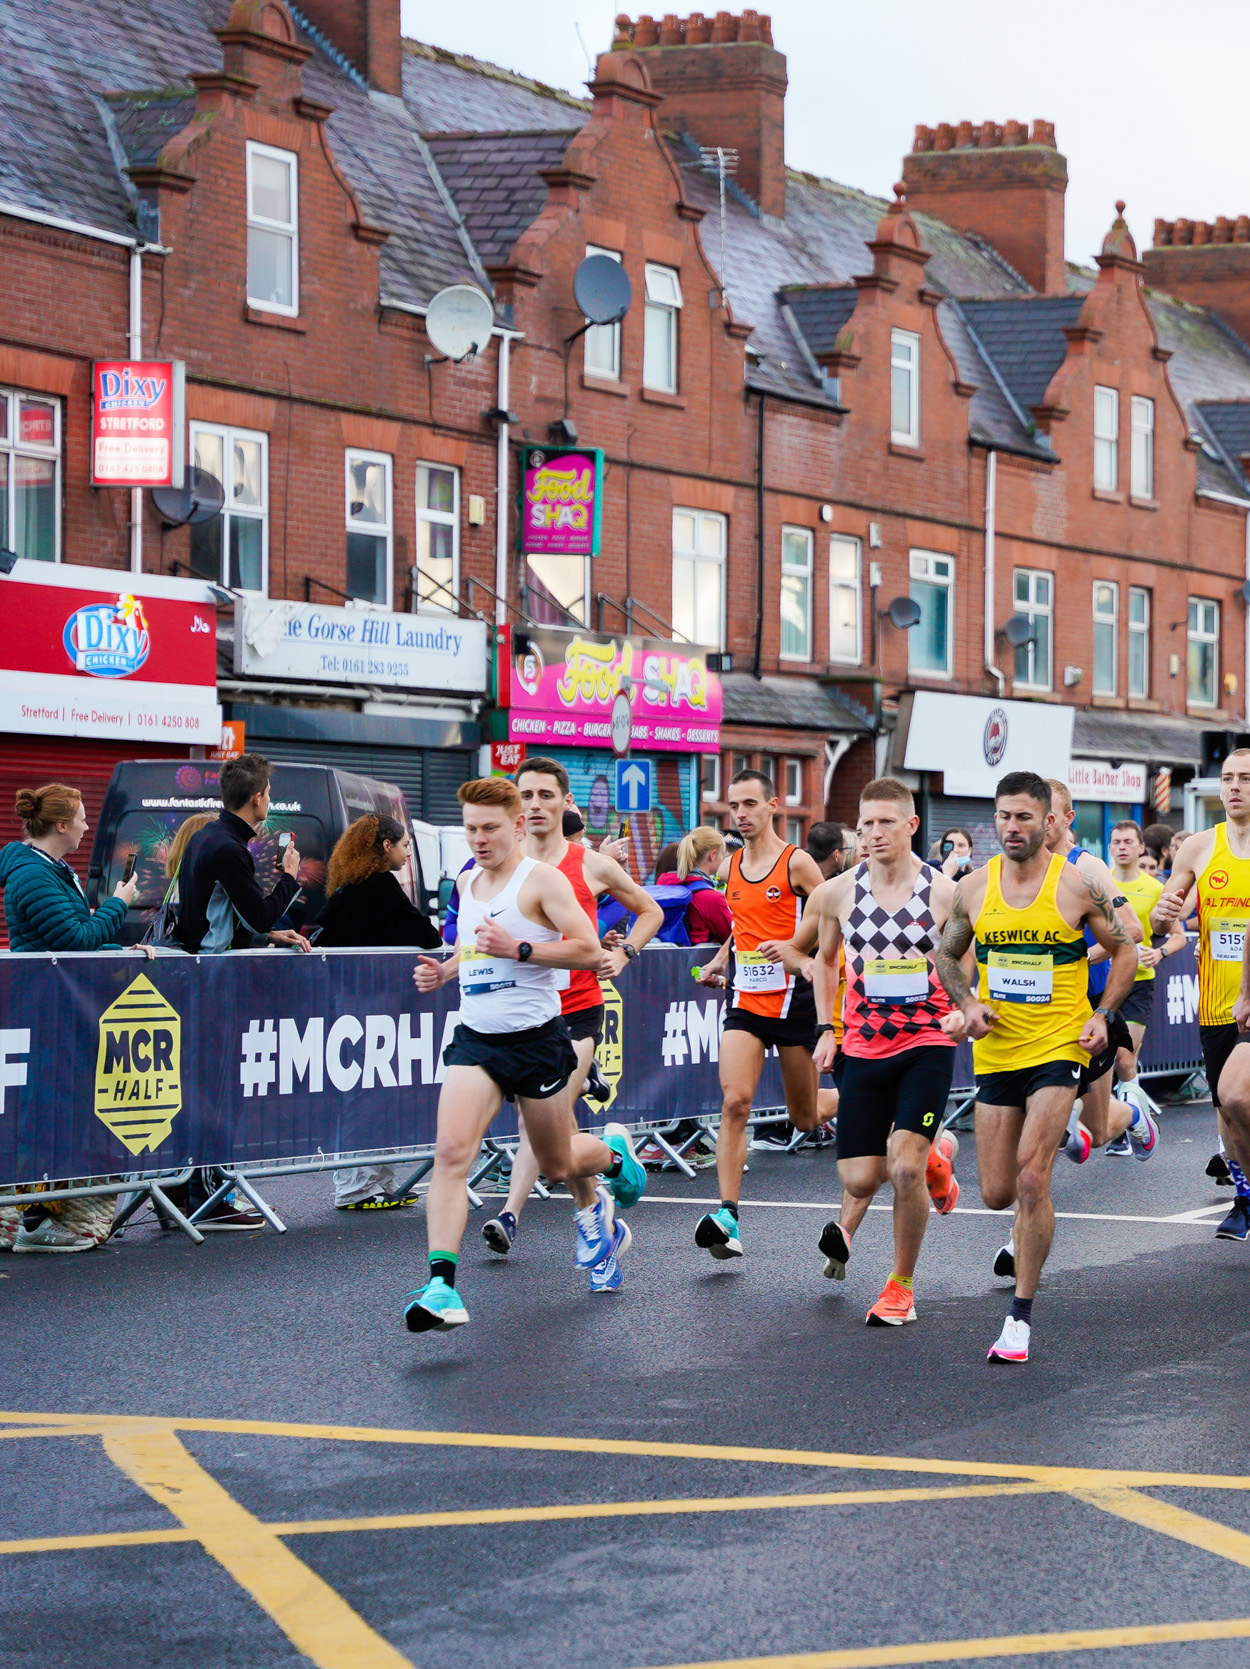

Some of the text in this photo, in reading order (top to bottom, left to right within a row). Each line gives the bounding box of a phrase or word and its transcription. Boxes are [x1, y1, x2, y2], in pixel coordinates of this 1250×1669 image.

[100, 367, 166, 405] Dixy
[100, 417, 165, 431] STRETFORD
[527, 467, 593, 504] Food
[530, 504, 588, 531] SHAQ
[84, 611, 147, 661] Dixy
[307, 613, 355, 643] Gorse
[360, 618, 390, 645] Hill
[395, 622, 463, 657] Laundry
[86, 655, 127, 666] CHICKEN
[320, 654, 340, 672] Tel:
[342, 658, 365, 675] 0161
[368, 659, 385, 675] 283
[557, 635, 708, 710] Food SHAQ
[21, 704, 200, 729] Stretford Free Delivery 0161 4250 808
[511, 717, 546, 734] CHICKEN
[552, 720, 576, 736] PIZZA
[653, 726, 682, 741] SHAKES
[686, 728, 719, 744] DESSERTS
[496, 744, 521, 756] JUST
[500, 753, 520, 766] EAT
[1067, 767, 1142, 790] Little Barber Shop
[985, 930, 1061, 944] KESWICK AC
[468, 967, 495, 977] LEWIS
[743, 965, 776, 977] 51632
[1001, 977, 1037, 987] WALSH
[1025, 995, 1051, 1003] 50024
[103, 1028, 174, 1074] MCR
[113, 1079, 164, 1102] HALF
